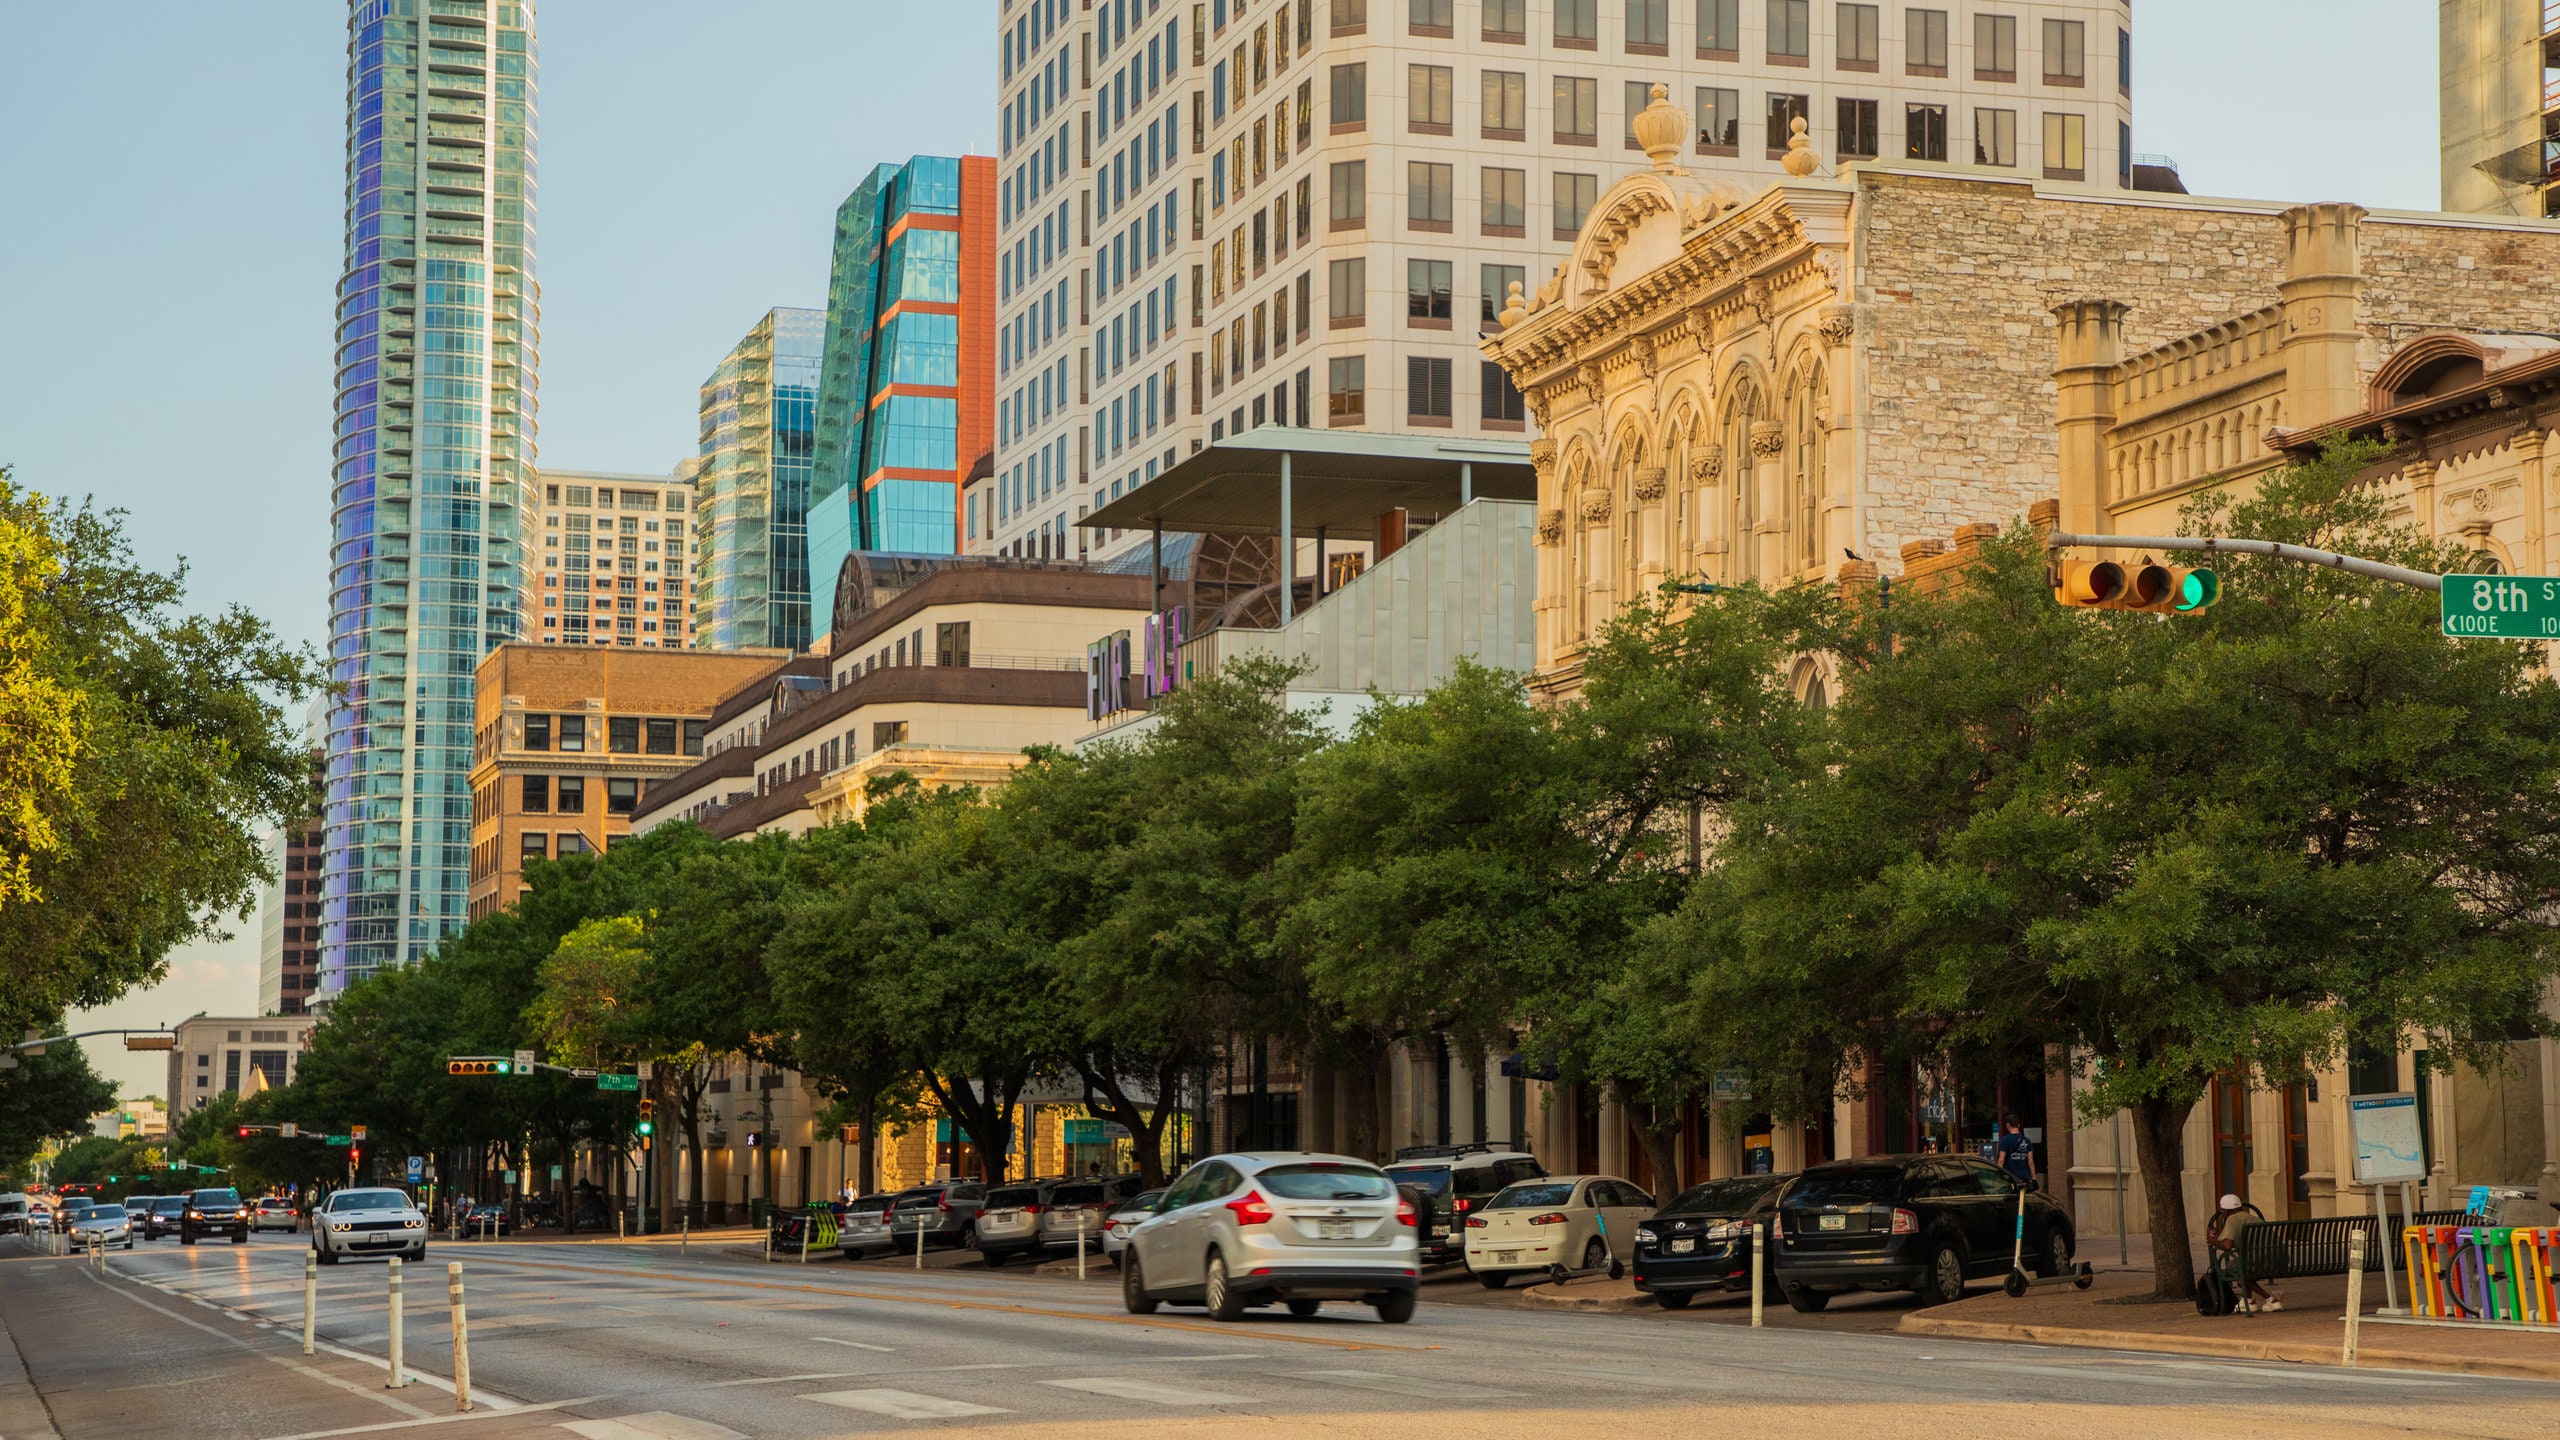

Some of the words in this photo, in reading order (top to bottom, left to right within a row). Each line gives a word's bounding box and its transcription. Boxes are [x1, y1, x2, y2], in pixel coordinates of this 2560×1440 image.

[2473, 580, 2528, 612] 8th
[2542, 581, 2560, 601] S
[2541, 617, 2560, 634] 10
[1087, 629, 1131, 720] FOR
[607, 1075, 621, 1084] 7th
[1756, 1149, 1763, 1160] P
[412, 1159, 419, 1168] P
